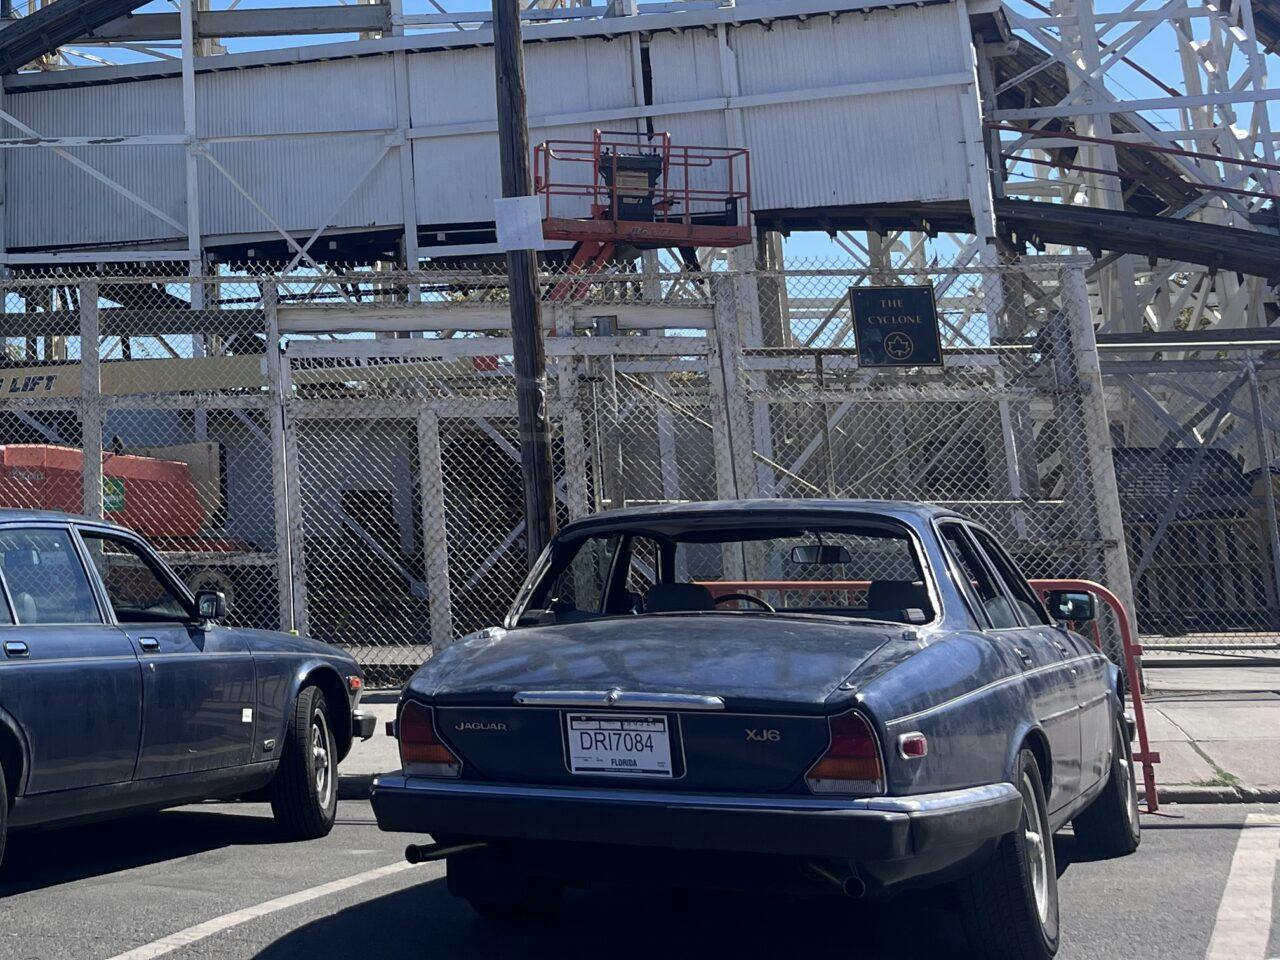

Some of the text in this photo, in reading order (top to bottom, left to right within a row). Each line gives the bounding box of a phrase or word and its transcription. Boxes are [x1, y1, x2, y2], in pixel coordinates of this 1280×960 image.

[880, 298, 904, 308] THE
[867, 315, 923, 325] CYCLONE
[8, 374, 58, 393] LIFT
[455, 721, 508, 732] JAGUAR
[744, 728, 781, 742] XJ6
[579, 731, 654, 753] DRI7084
[610, 758, 638, 767] FLORIDA
